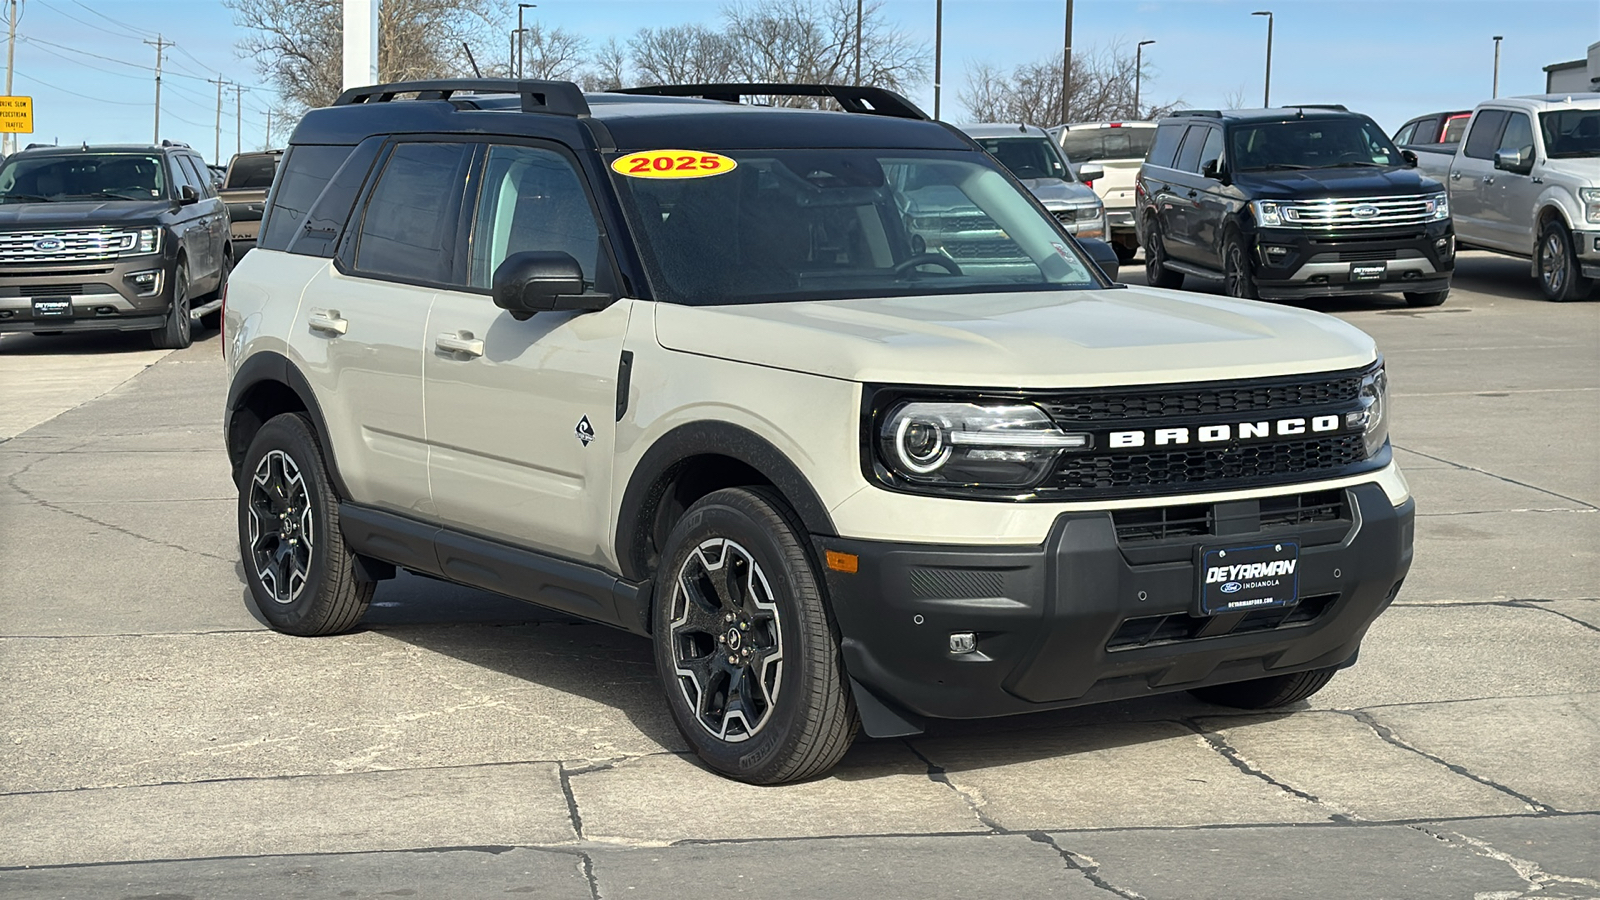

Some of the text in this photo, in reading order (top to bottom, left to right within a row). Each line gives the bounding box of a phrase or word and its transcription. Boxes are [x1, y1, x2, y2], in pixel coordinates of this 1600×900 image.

[629, 156, 721, 173] 2025
[1109, 415, 1339, 448] BRONCO
[1206, 559, 1296, 584] DEYARMAN
[1243, 579, 1280, 589] INDIANOLA
[1228, 597, 1273, 608] DEYARMANFORD.COM
